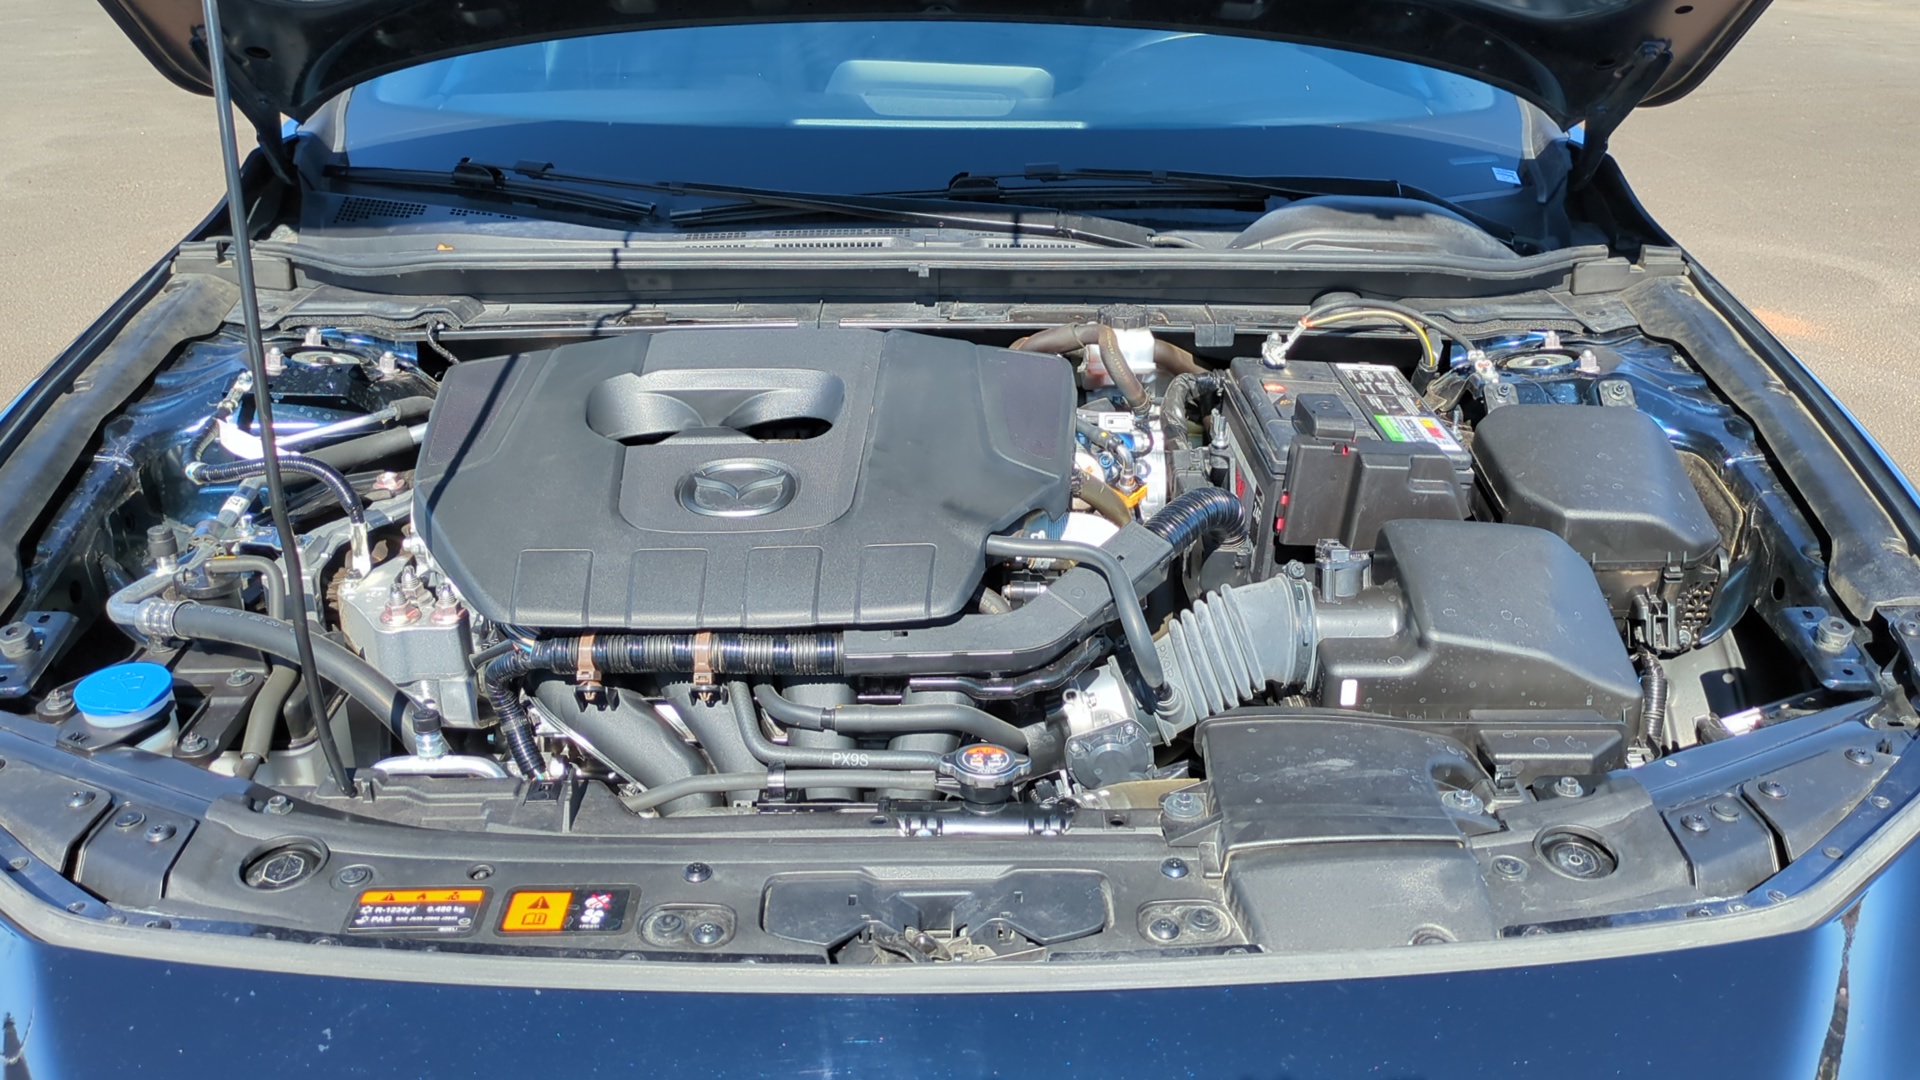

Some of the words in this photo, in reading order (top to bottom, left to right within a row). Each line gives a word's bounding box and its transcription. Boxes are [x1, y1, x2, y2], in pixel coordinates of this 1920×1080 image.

[831, 752, 869, 767] PX9S
[374, 905, 416, 915] R-1234yf
[453, 905, 466, 914] kg
[371, 915, 392, 923] PAG
